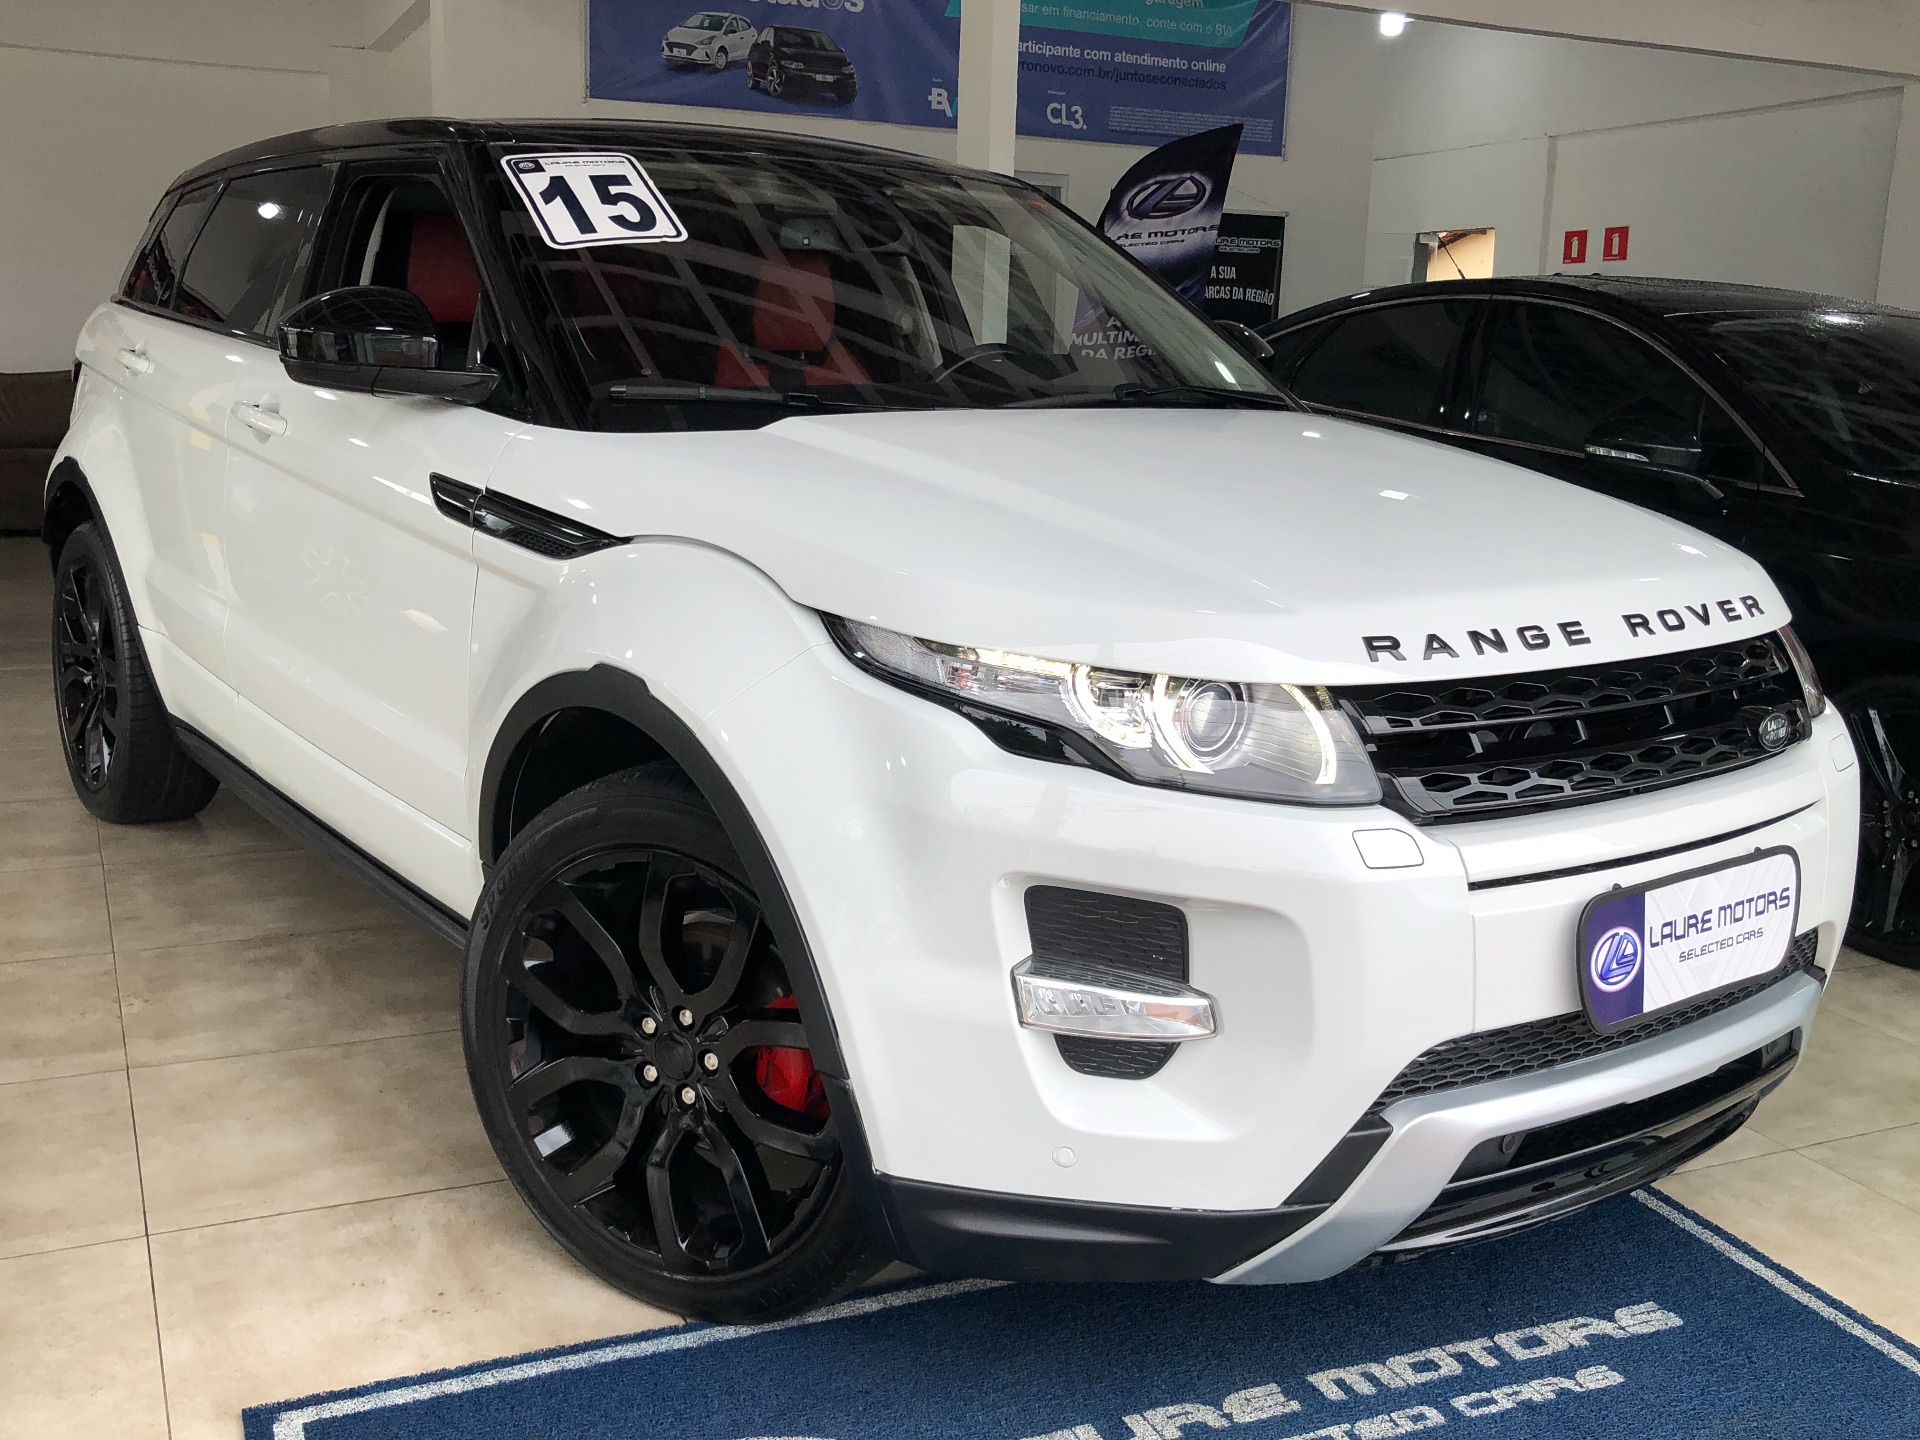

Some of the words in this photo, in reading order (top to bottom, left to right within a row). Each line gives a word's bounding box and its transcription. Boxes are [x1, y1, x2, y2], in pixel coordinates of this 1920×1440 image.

[1042, 5, 1060, 16] em
[1063, 6, 1142, 27] financiamento,
[1146, 18, 1177, 30] conte
[1180, 22, 1203, 33] com
[1084, 48, 1111, 61] com
[1114, 50, 1188, 70] atendimento
[1191, 60, 1227, 73] online
[538, 174, 657, 235] 15
[1114, 231, 1143, 241] RE
[1147, 224, 1220, 239] MOTORS
[1239, 237, 1281, 249] MOTORS
[1210, 265, 1217, 279] A
[1218, 265, 1236, 280] SUA
[1232, 286, 1244, 300] DA
[1245, 288, 1275, 306] REGIÃO
[1072, 330, 1140, 346] MULTIM
[1362, 620, 1592, 662] RANGE
[1620, 594, 1766, 638] ROVER
[1649, 909, 1713, 949] LAURE
[1717, 886, 1791, 929] MOTORS
[1679, 936, 1734, 963] SELECTED
[1735, 927, 1764, 946] CARS
[1306, 1302, 1684, 1401] MOTORS
[1449, 1365, 1626, 1418] CARS
